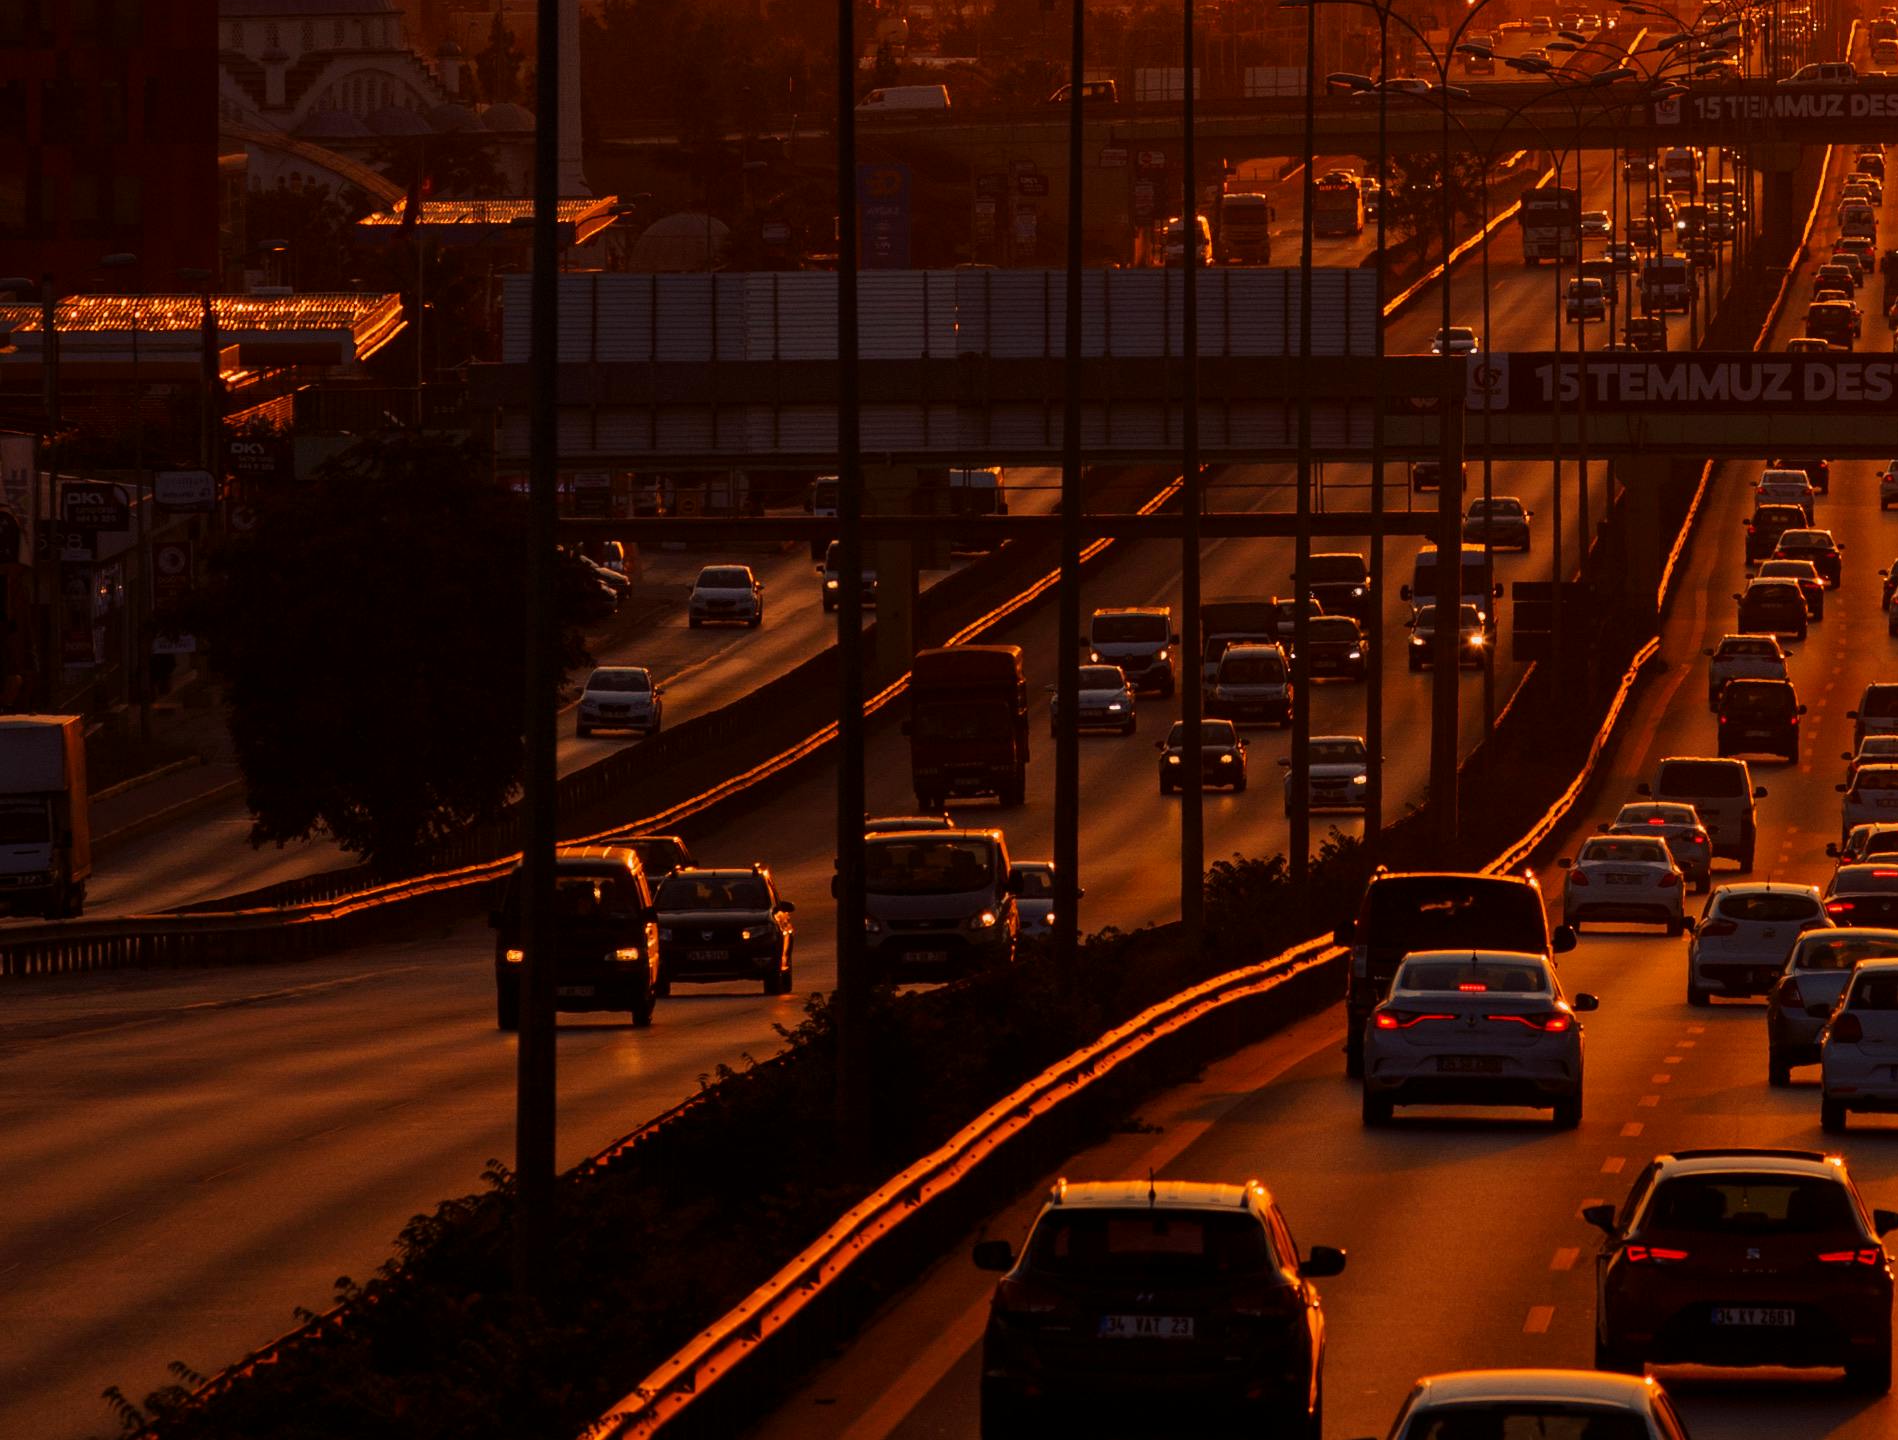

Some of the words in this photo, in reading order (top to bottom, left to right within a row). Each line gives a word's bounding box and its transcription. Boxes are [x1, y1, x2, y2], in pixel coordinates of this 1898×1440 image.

[1694, 95, 1722, 119] 15
[1725, 94, 1845, 119] TEMMUZ
[1535, 363, 1580, 401] 15
[1587, 363, 1793, 401] TEMMUZ
[1171, 1317, 1189, 1334] 23
